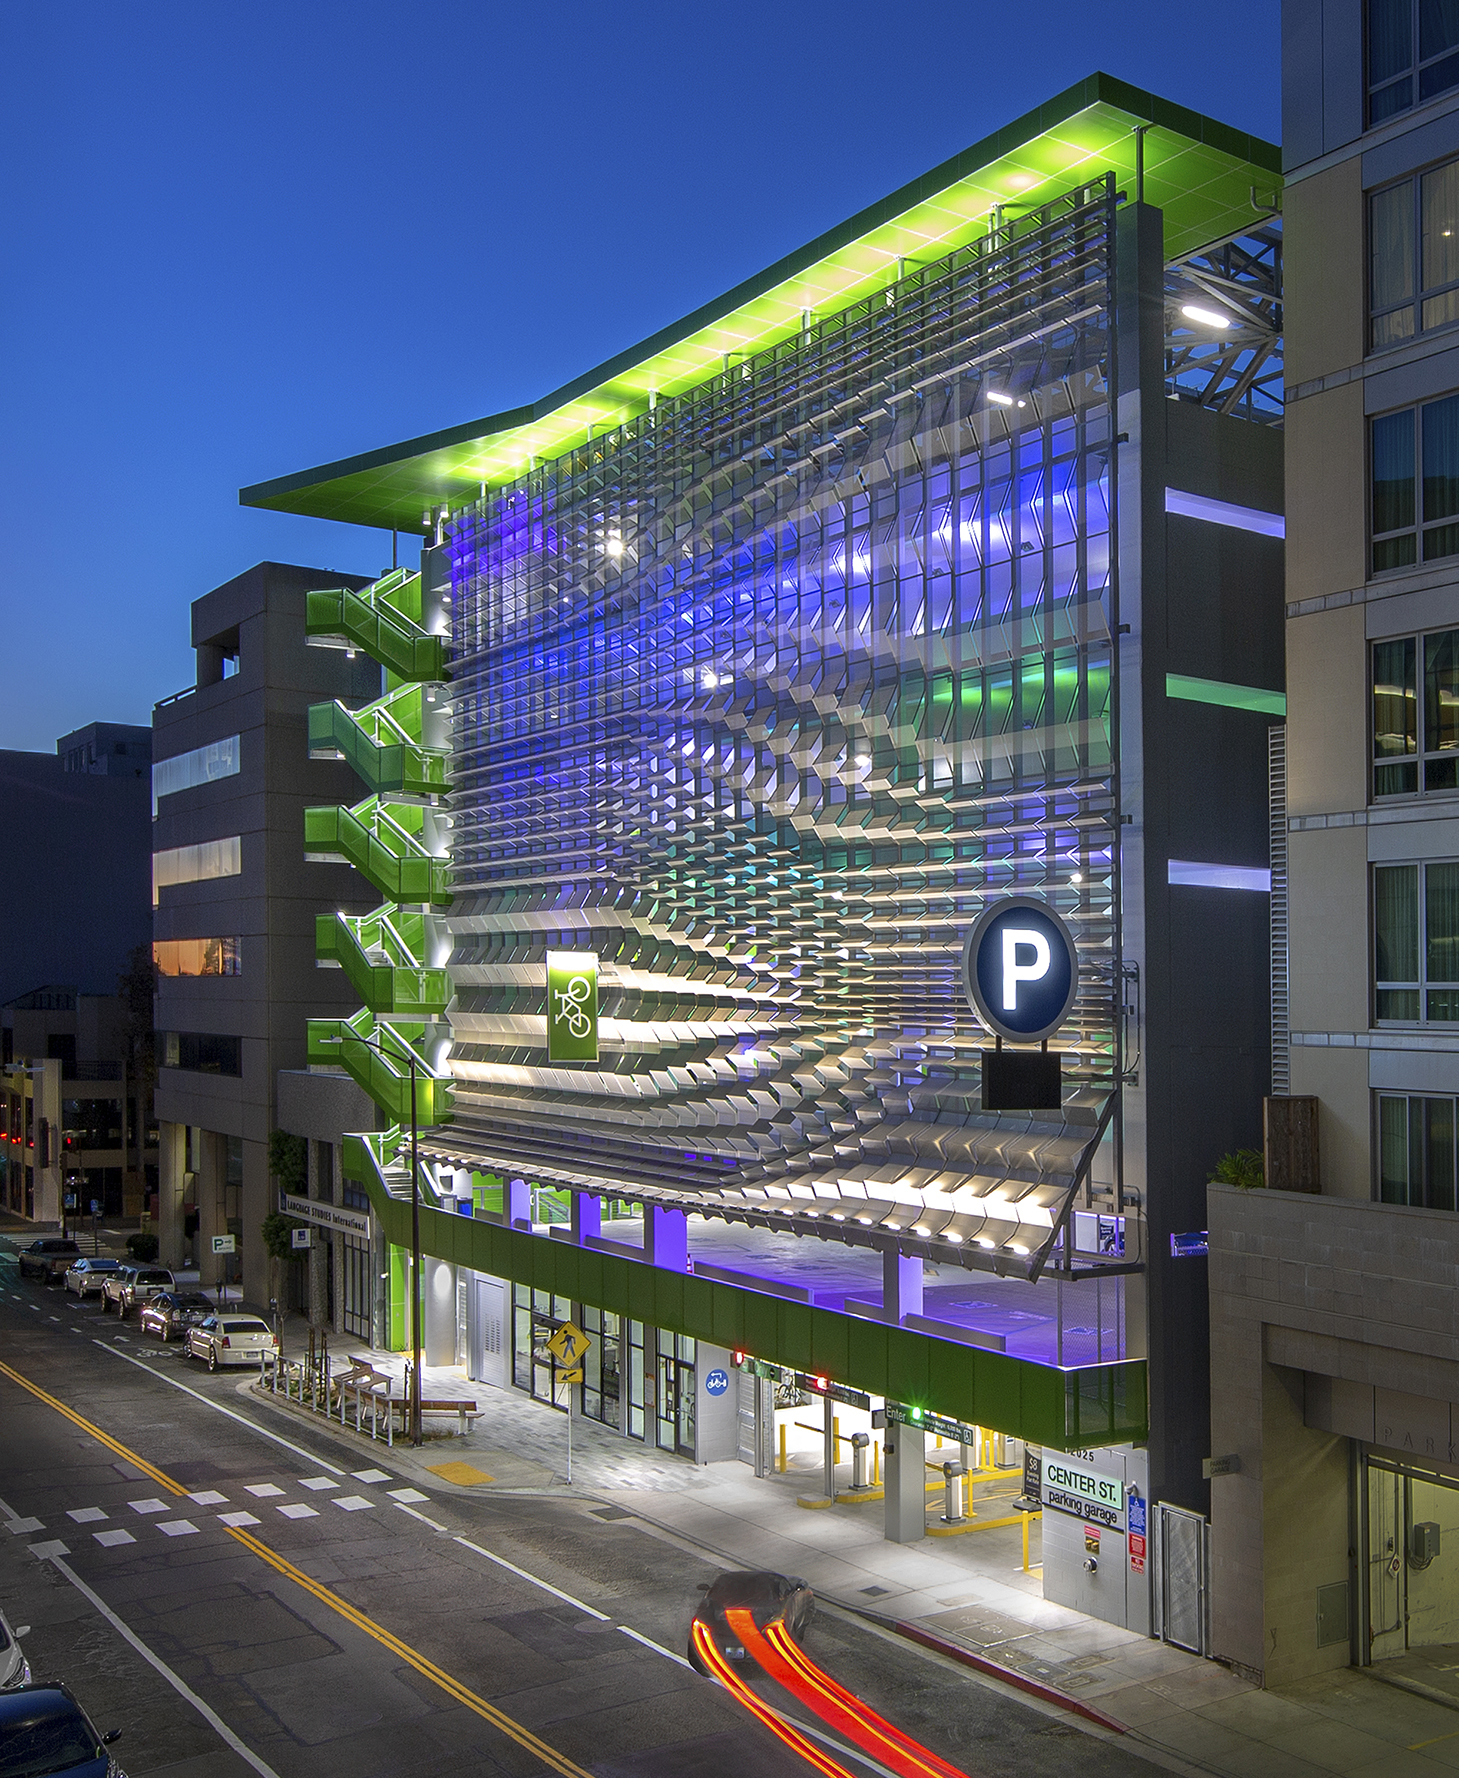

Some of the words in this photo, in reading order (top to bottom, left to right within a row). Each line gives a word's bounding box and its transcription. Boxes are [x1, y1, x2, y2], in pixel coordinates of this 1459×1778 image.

[1002, 928, 1051, 1010] P
[287, 1200, 310, 1216] LANGUAGE
[311, 1207, 331, 1222] STUDIES
[332, 1213, 366, 1232] International
[214, 1239, 224, 1251] P
[886, 1405, 906, 1422] Enter
[1047, 1464, 1096, 1495] CENTER
[1098, 1480, 1117, 1502] ST.
[1048, 1491, 1083, 1515] parking
[1084, 1503, 1118, 1526] garage
